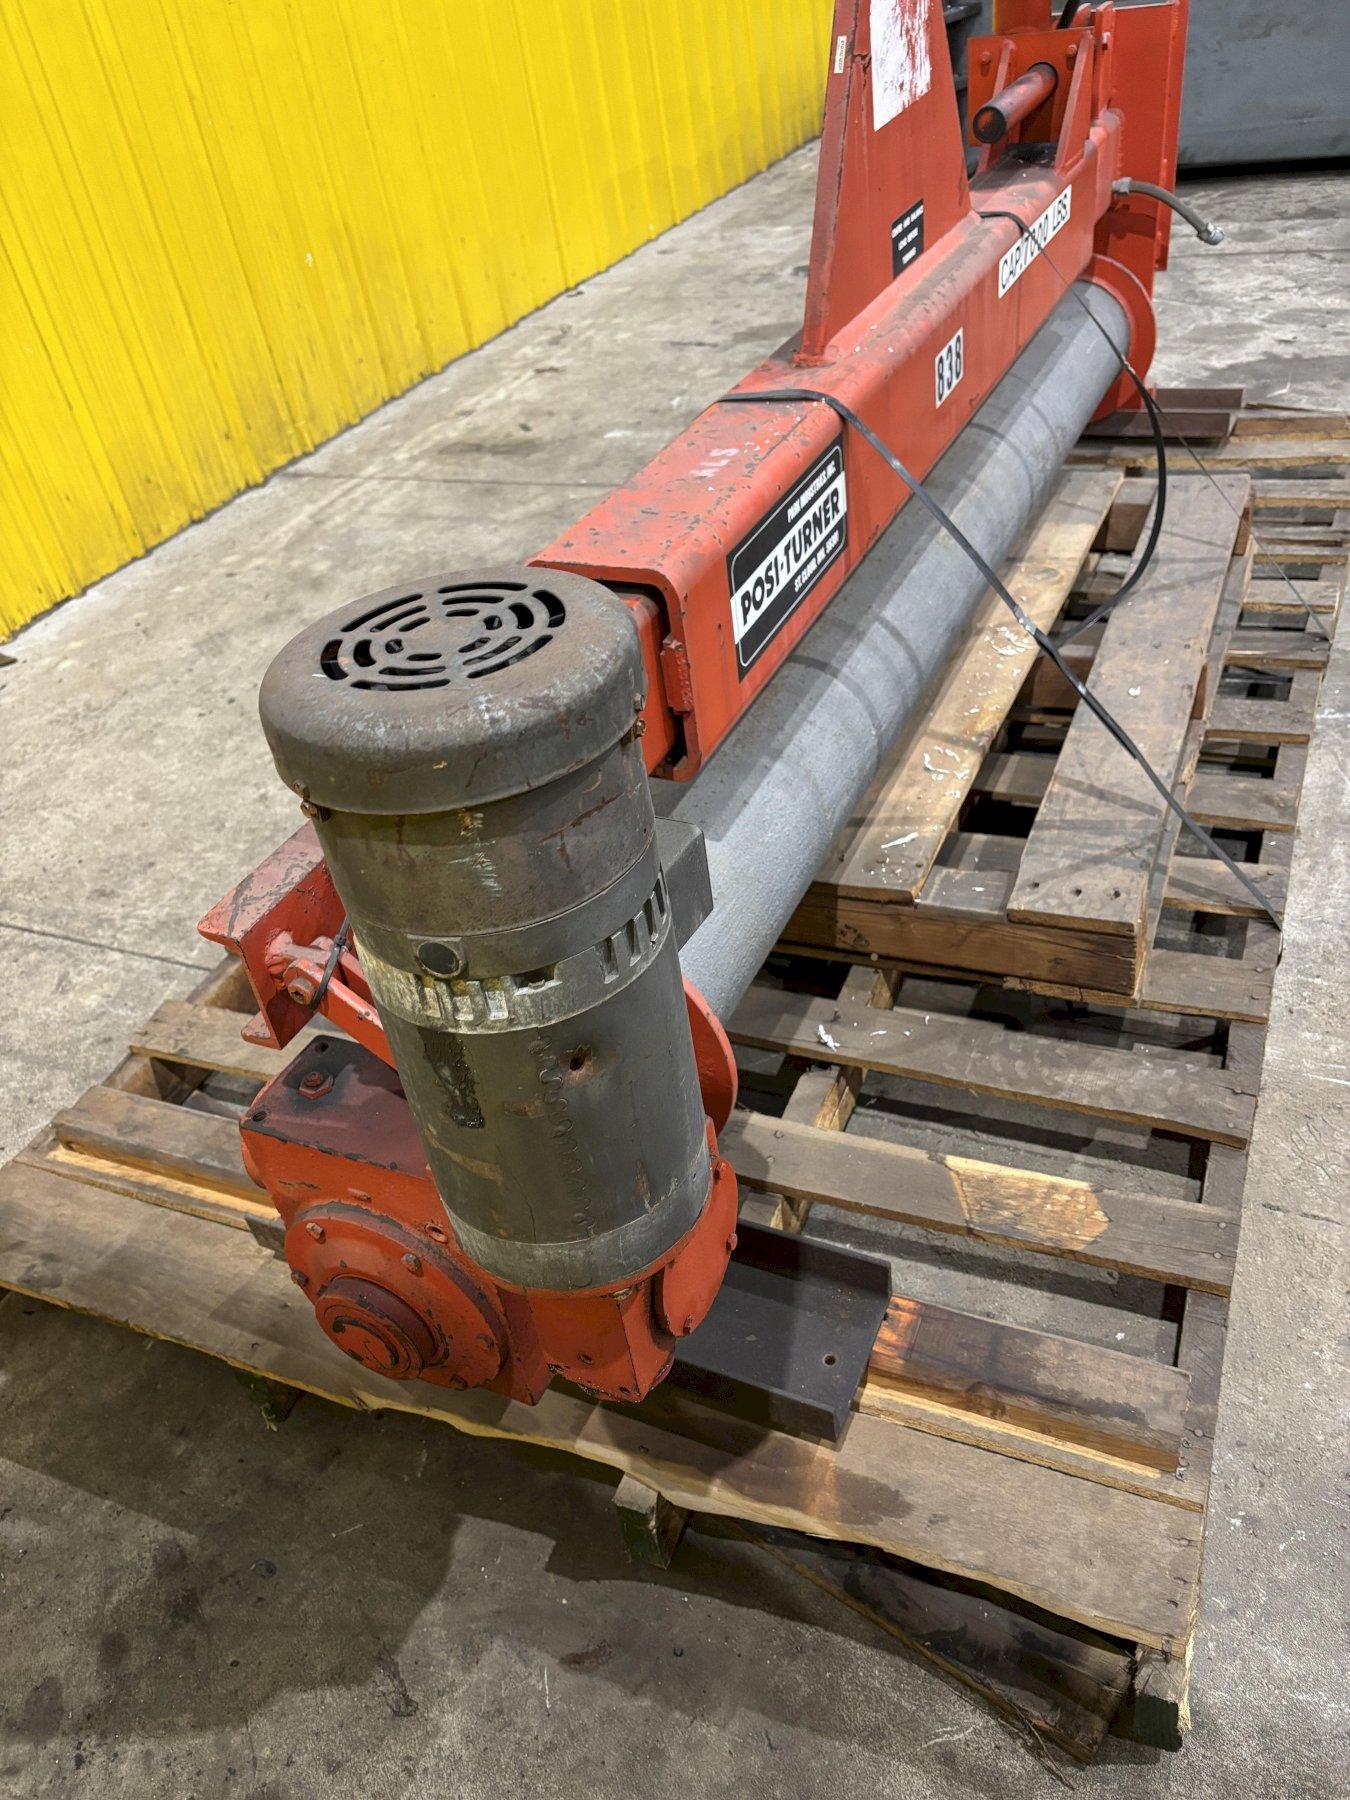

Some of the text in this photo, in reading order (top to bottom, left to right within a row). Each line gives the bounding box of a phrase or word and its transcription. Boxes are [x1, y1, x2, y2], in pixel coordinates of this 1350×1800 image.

[1053, 193, 1068, 232] LBS
[938, 334, 962, 402] 838
[740, 487, 840, 626] POSI-TURNER
